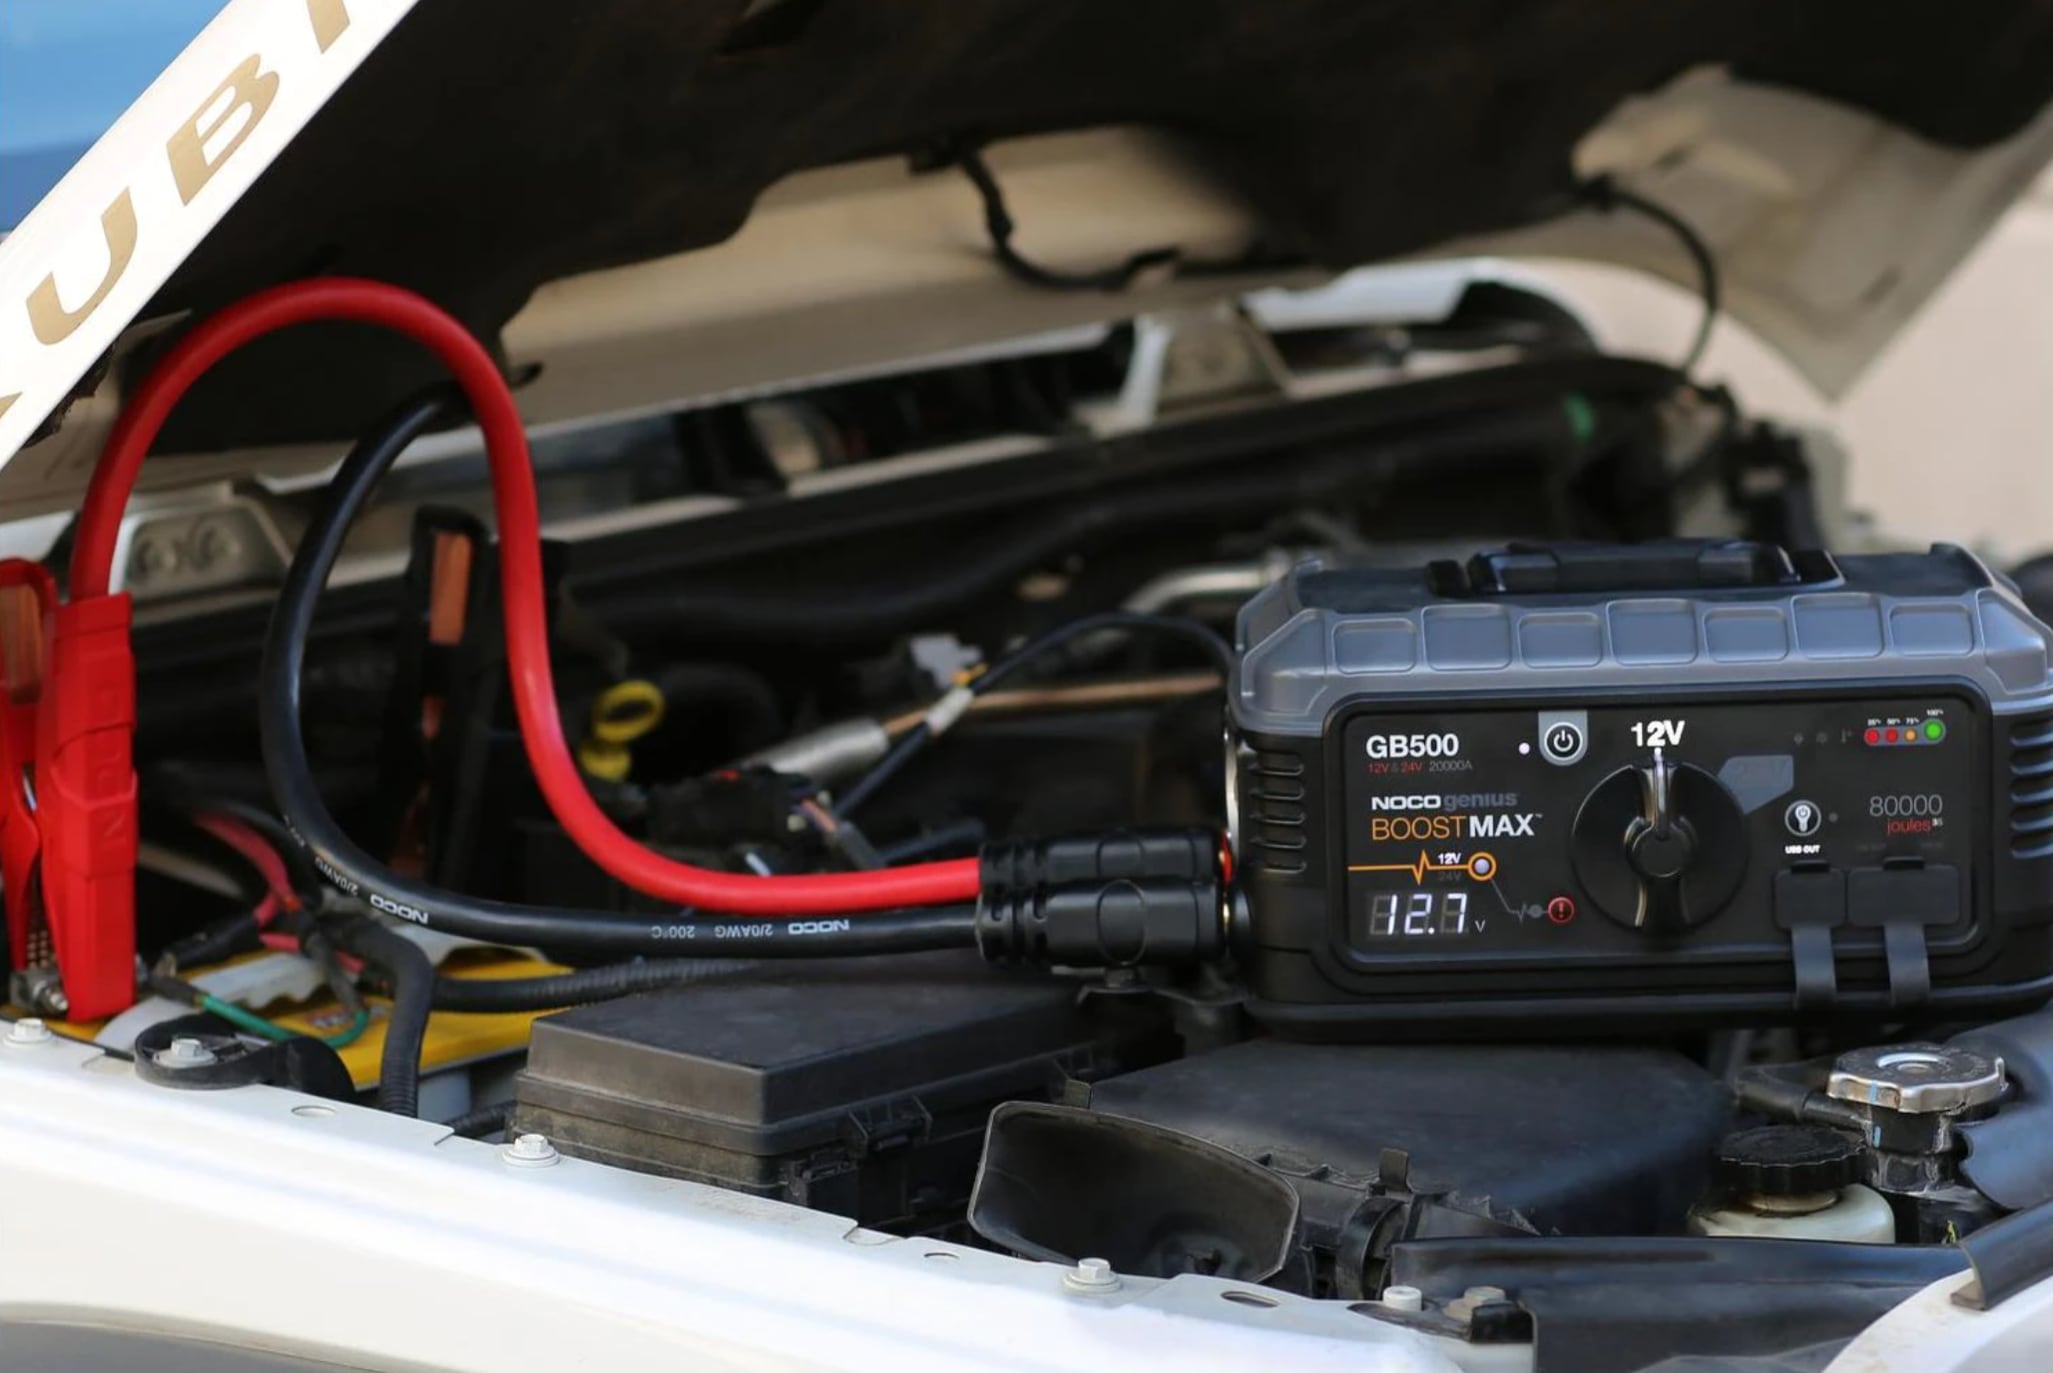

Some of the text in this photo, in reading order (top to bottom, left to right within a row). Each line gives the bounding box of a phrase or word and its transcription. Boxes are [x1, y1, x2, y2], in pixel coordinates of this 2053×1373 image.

[0, 0, 351, 418] UB
[1631, 720, 1685, 747] 12V
[1366, 733, 1460, 759] GB500
[1368, 762, 1390, 774] 12V
[1400, 761, 1424, 773] 24V
[1429, 760, 1472, 773] 20000A
[1869, 794, 1943, 816] 80000
[1437, 852, 1462, 864] 12V
[370, 894, 429, 925] NOCO
[1386, 893, 1468, 936] 12.7
[713, 923, 773, 938] 2/0AWG
[788, 919, 849, 935] NOCO
